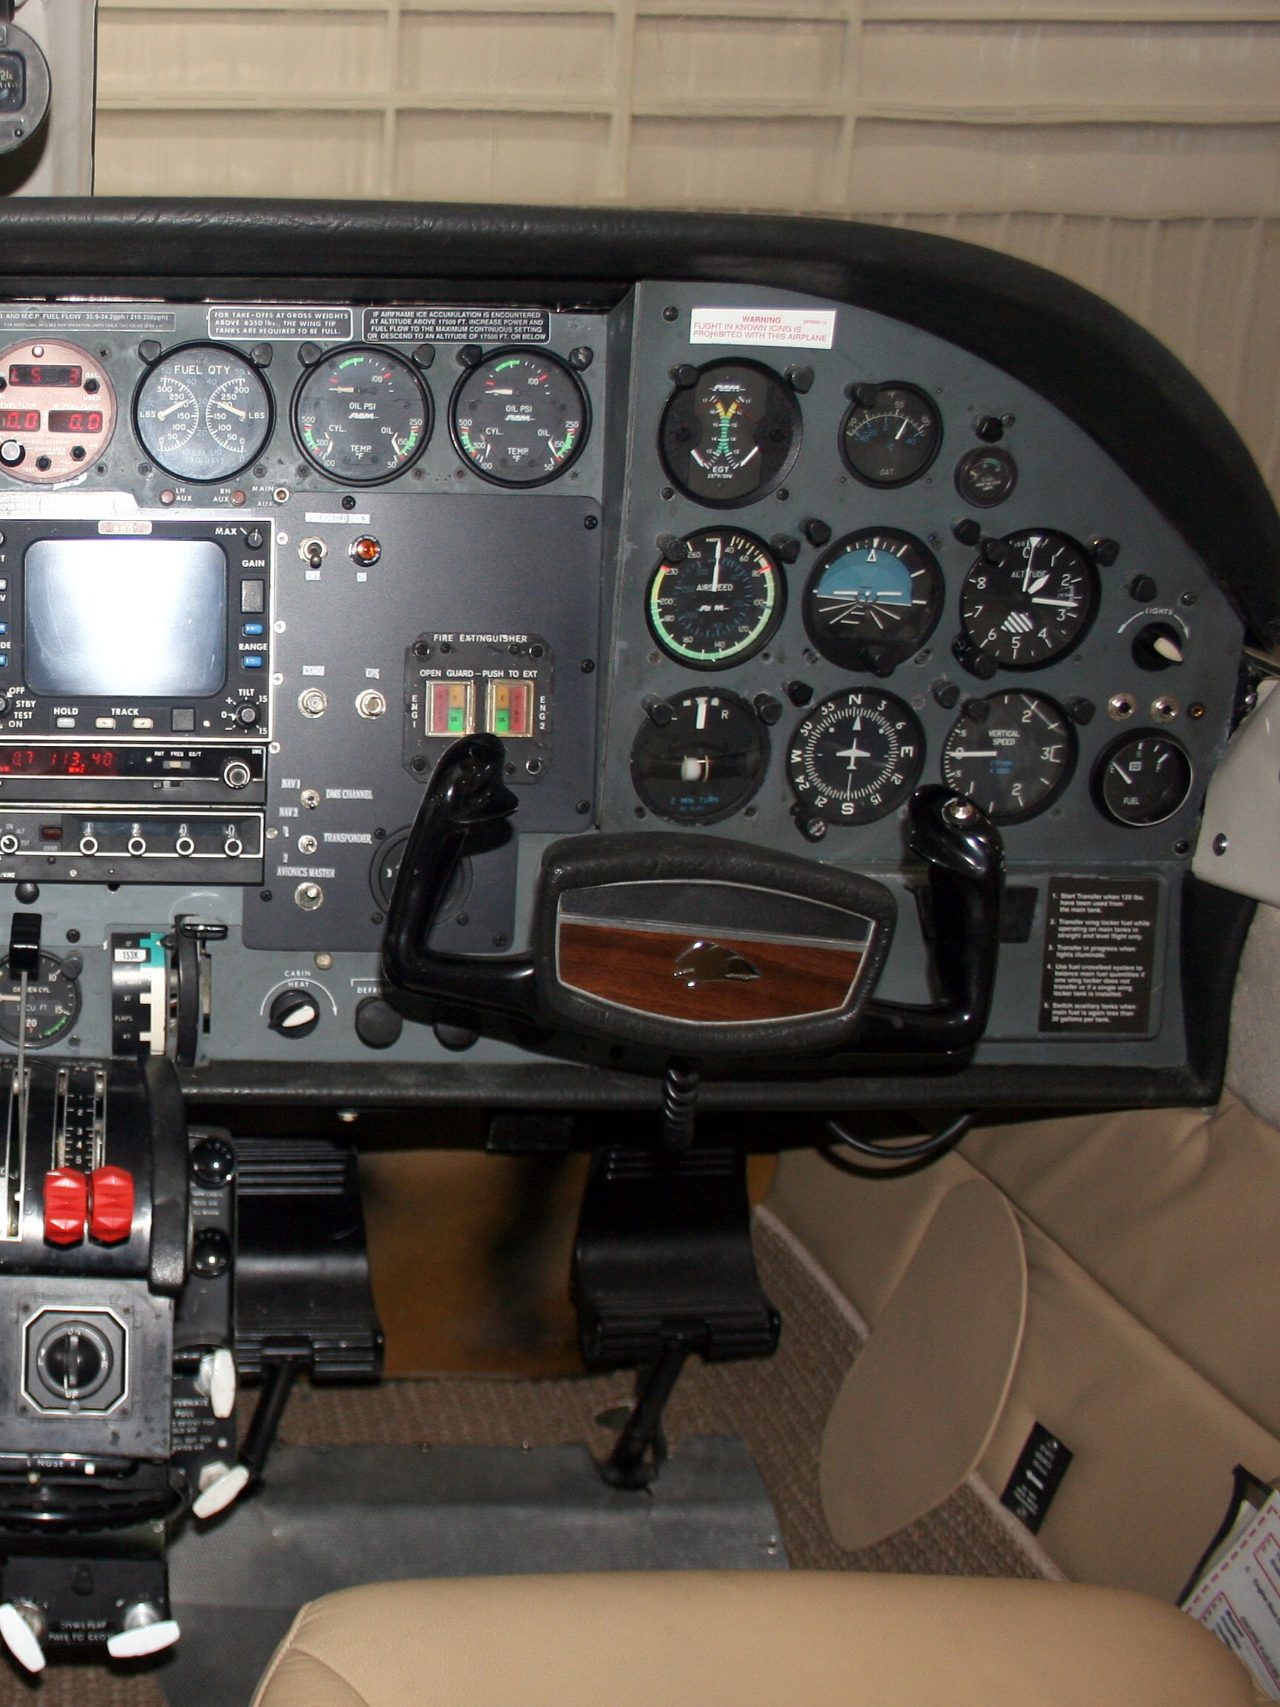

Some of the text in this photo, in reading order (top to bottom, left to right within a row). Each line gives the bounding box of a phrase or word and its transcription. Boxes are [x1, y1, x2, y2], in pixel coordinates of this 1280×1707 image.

[0, 71, 13, 81] 24
[742, 316, 781, 324] WARNING
[693, 331, 743, 339] PROHIBITED
[788, 334, 827, 342] AIRPLANE
[174, 365, 231, 375] FUEL QTY
[140, 411, 156, 419] LBS
[381, 426, 394, 435] OIL
[215, 528, 237, 536] MAX
[434, 634, 527, 643] FIRE EXTINGUISHER
[849, 694, 862, 705] N
[112, 708, 139, 716] TRACK
[988, 730, 1020, 738] VERTICAL
[992, 738, 1015, 746] SPEED
[326, 789, 373, 800] DME CHANNEL
[324, 833, 372, 844] TRANSPONDER
[277, 867, 335, 878] AVIONICS MASTER
